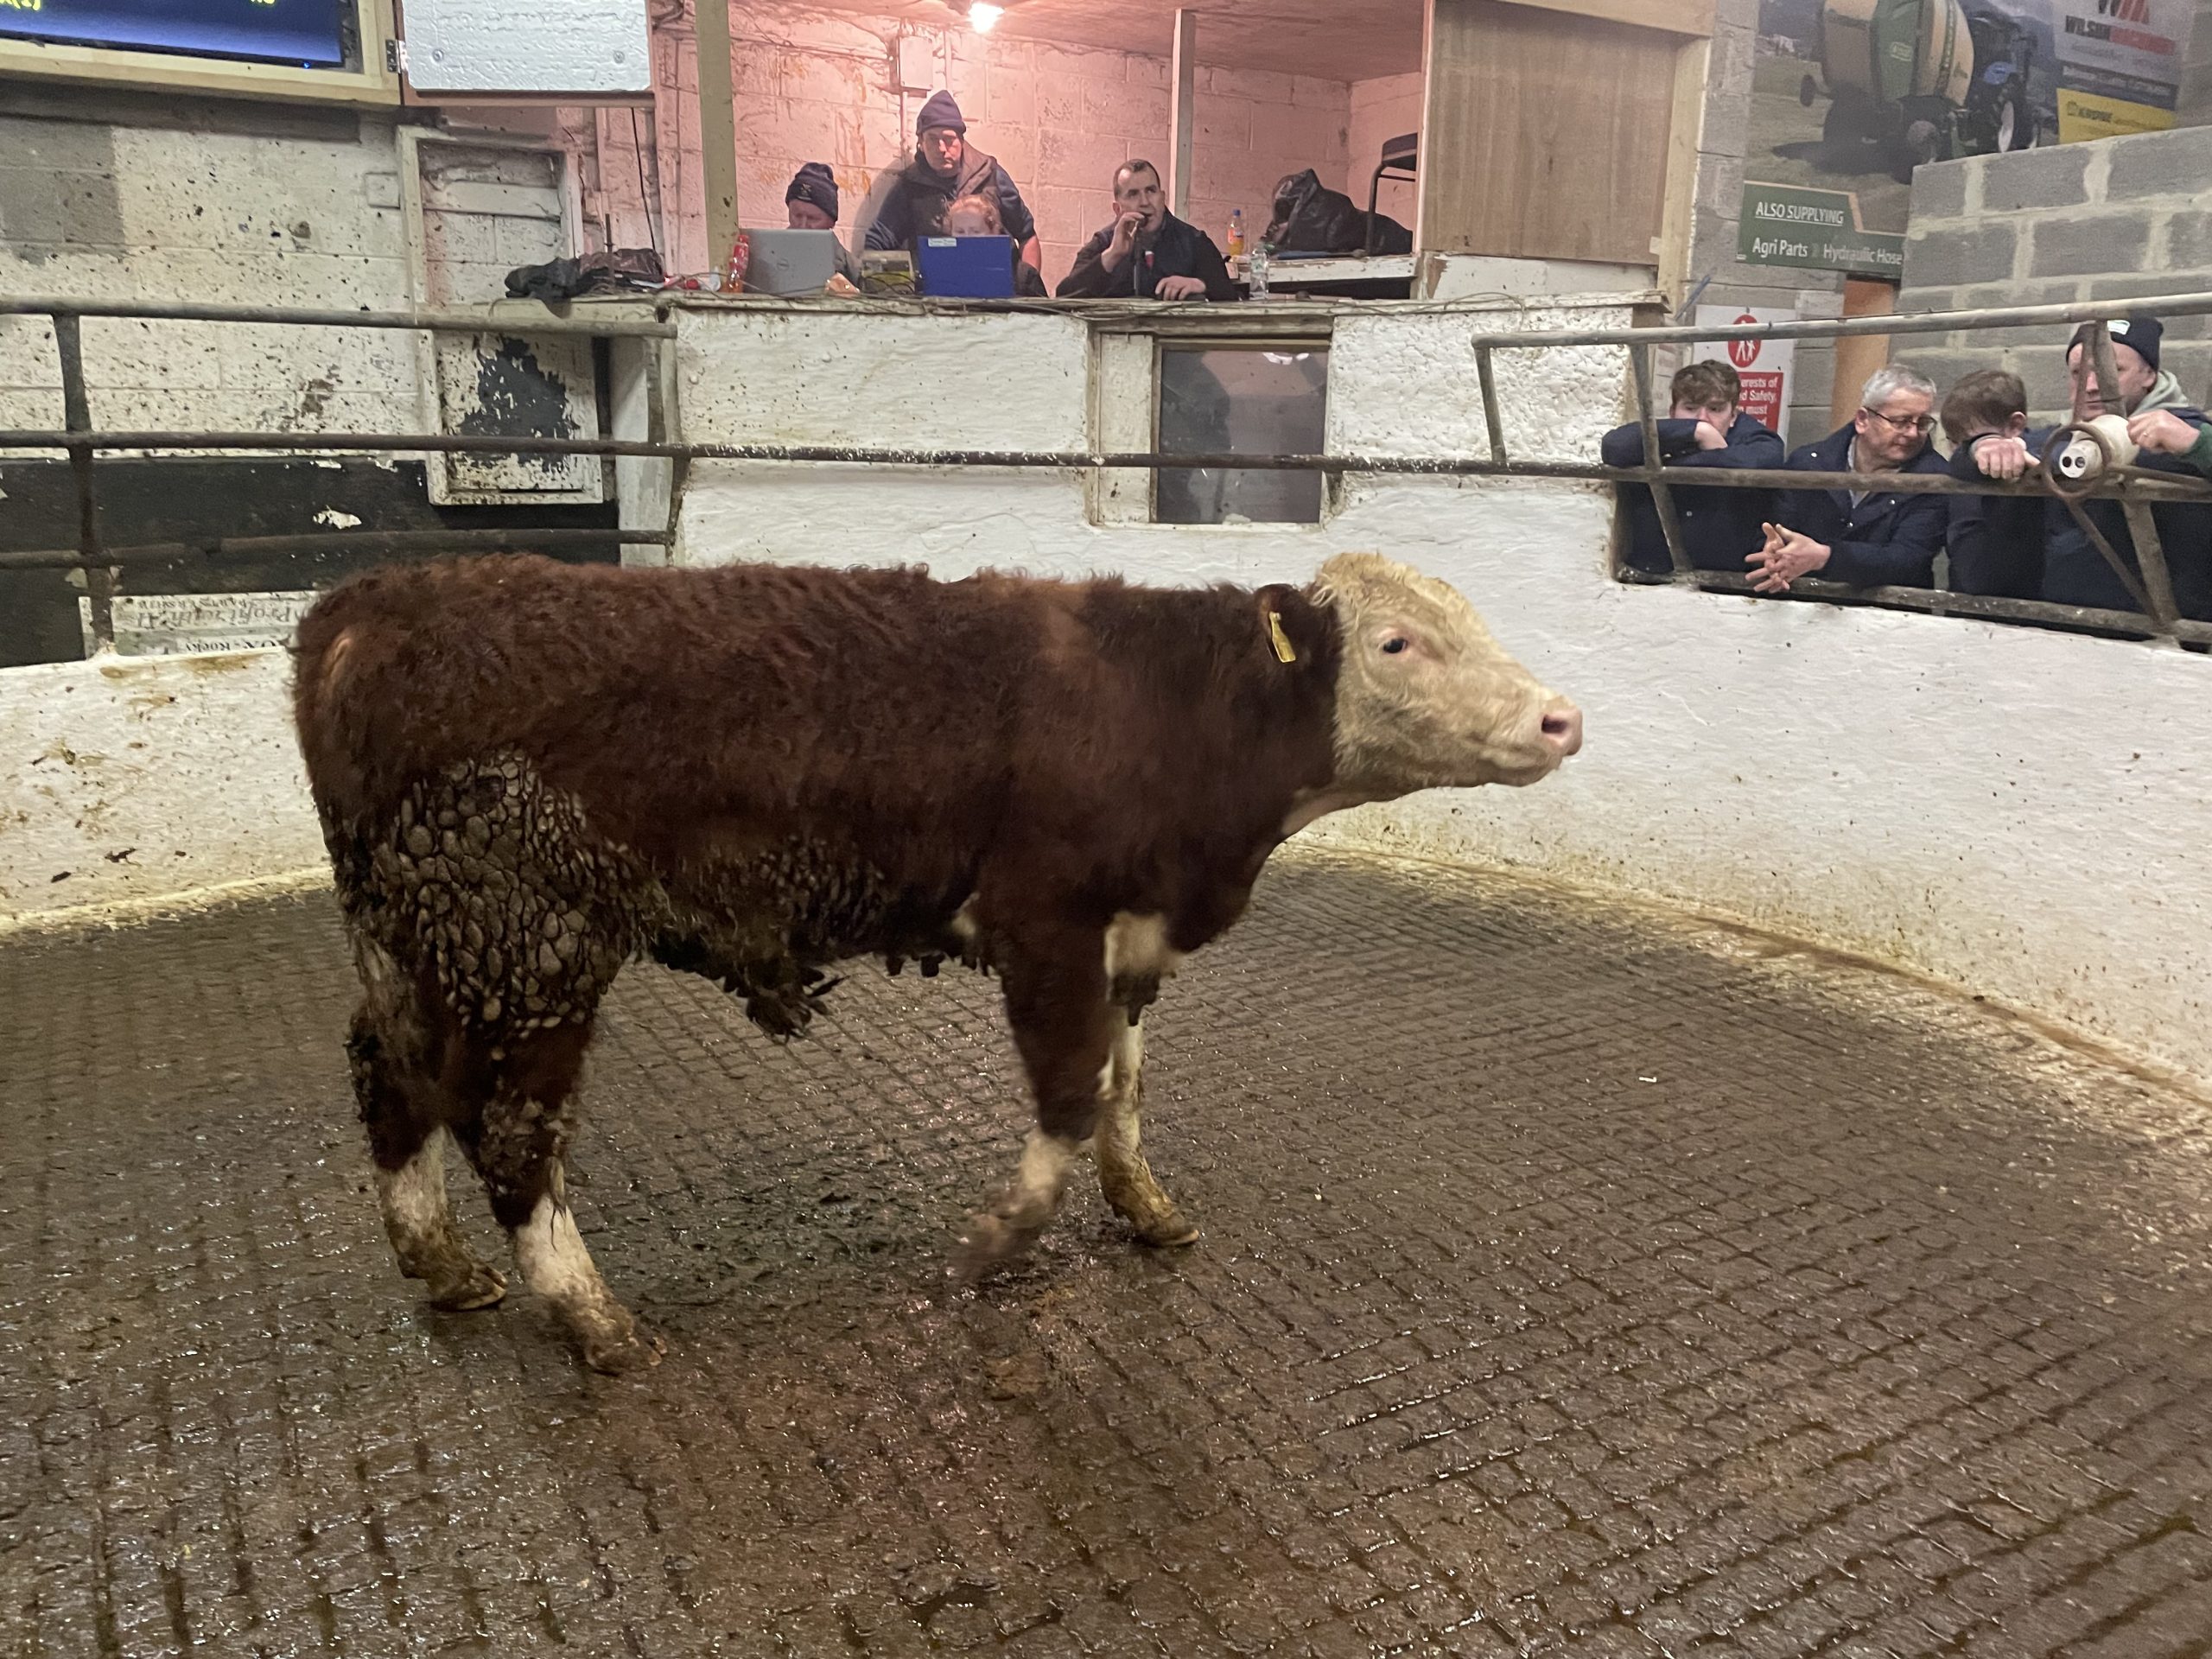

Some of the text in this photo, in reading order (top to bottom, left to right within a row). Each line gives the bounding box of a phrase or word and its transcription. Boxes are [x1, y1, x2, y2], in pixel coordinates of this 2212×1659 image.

[1755, 201, 1844, 225] ALSO SUPPLYING
[1752, 237, 1777, 258] Agri
[1779, 239, 1808, 257] Parts
[1823, 244, 1875, 263] Hydraulic
[1740, 377, 1778, 388] erests of
